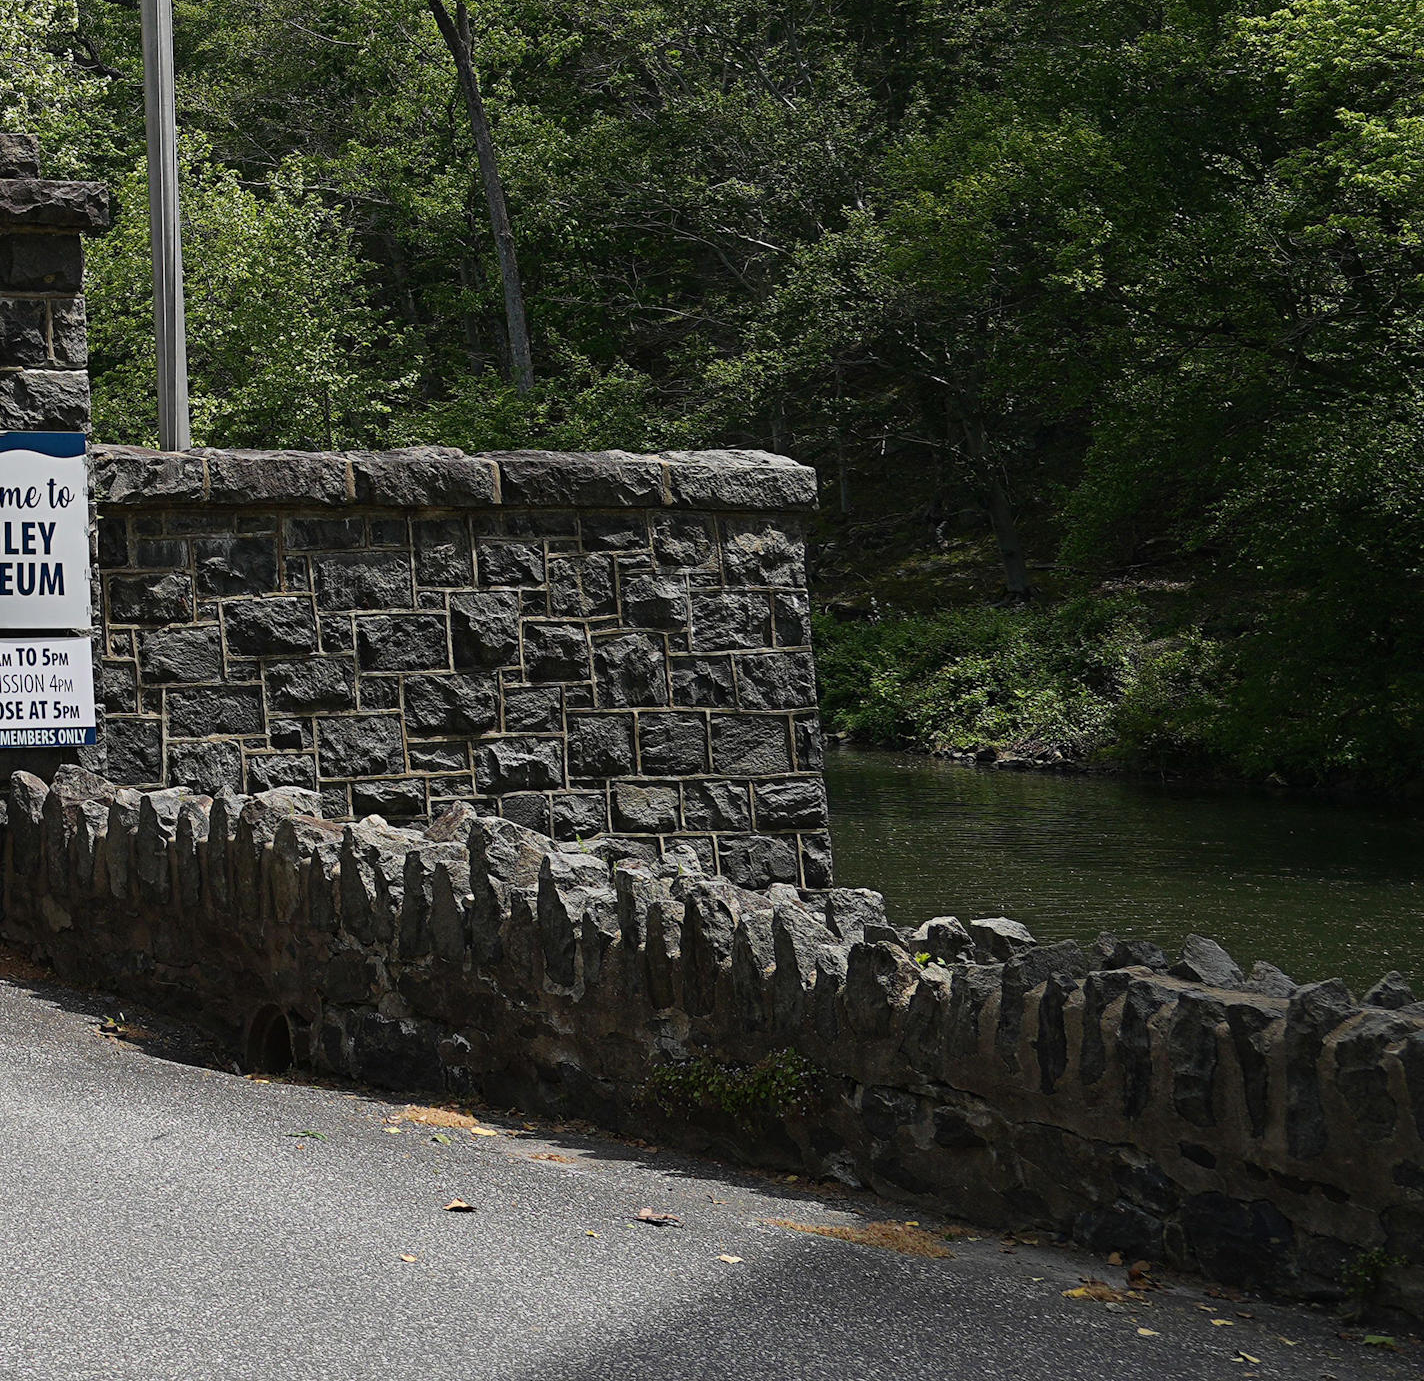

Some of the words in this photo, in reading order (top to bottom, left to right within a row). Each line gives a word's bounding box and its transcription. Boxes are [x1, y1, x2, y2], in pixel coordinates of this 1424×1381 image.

[47, 478, 75, 509] to
[16, 648, 36, 666] TO
[29, 701, 48, 719] AT
[0, 730, 56, 745] MEMBERS
[58, 729, 86, 744] ONLY
